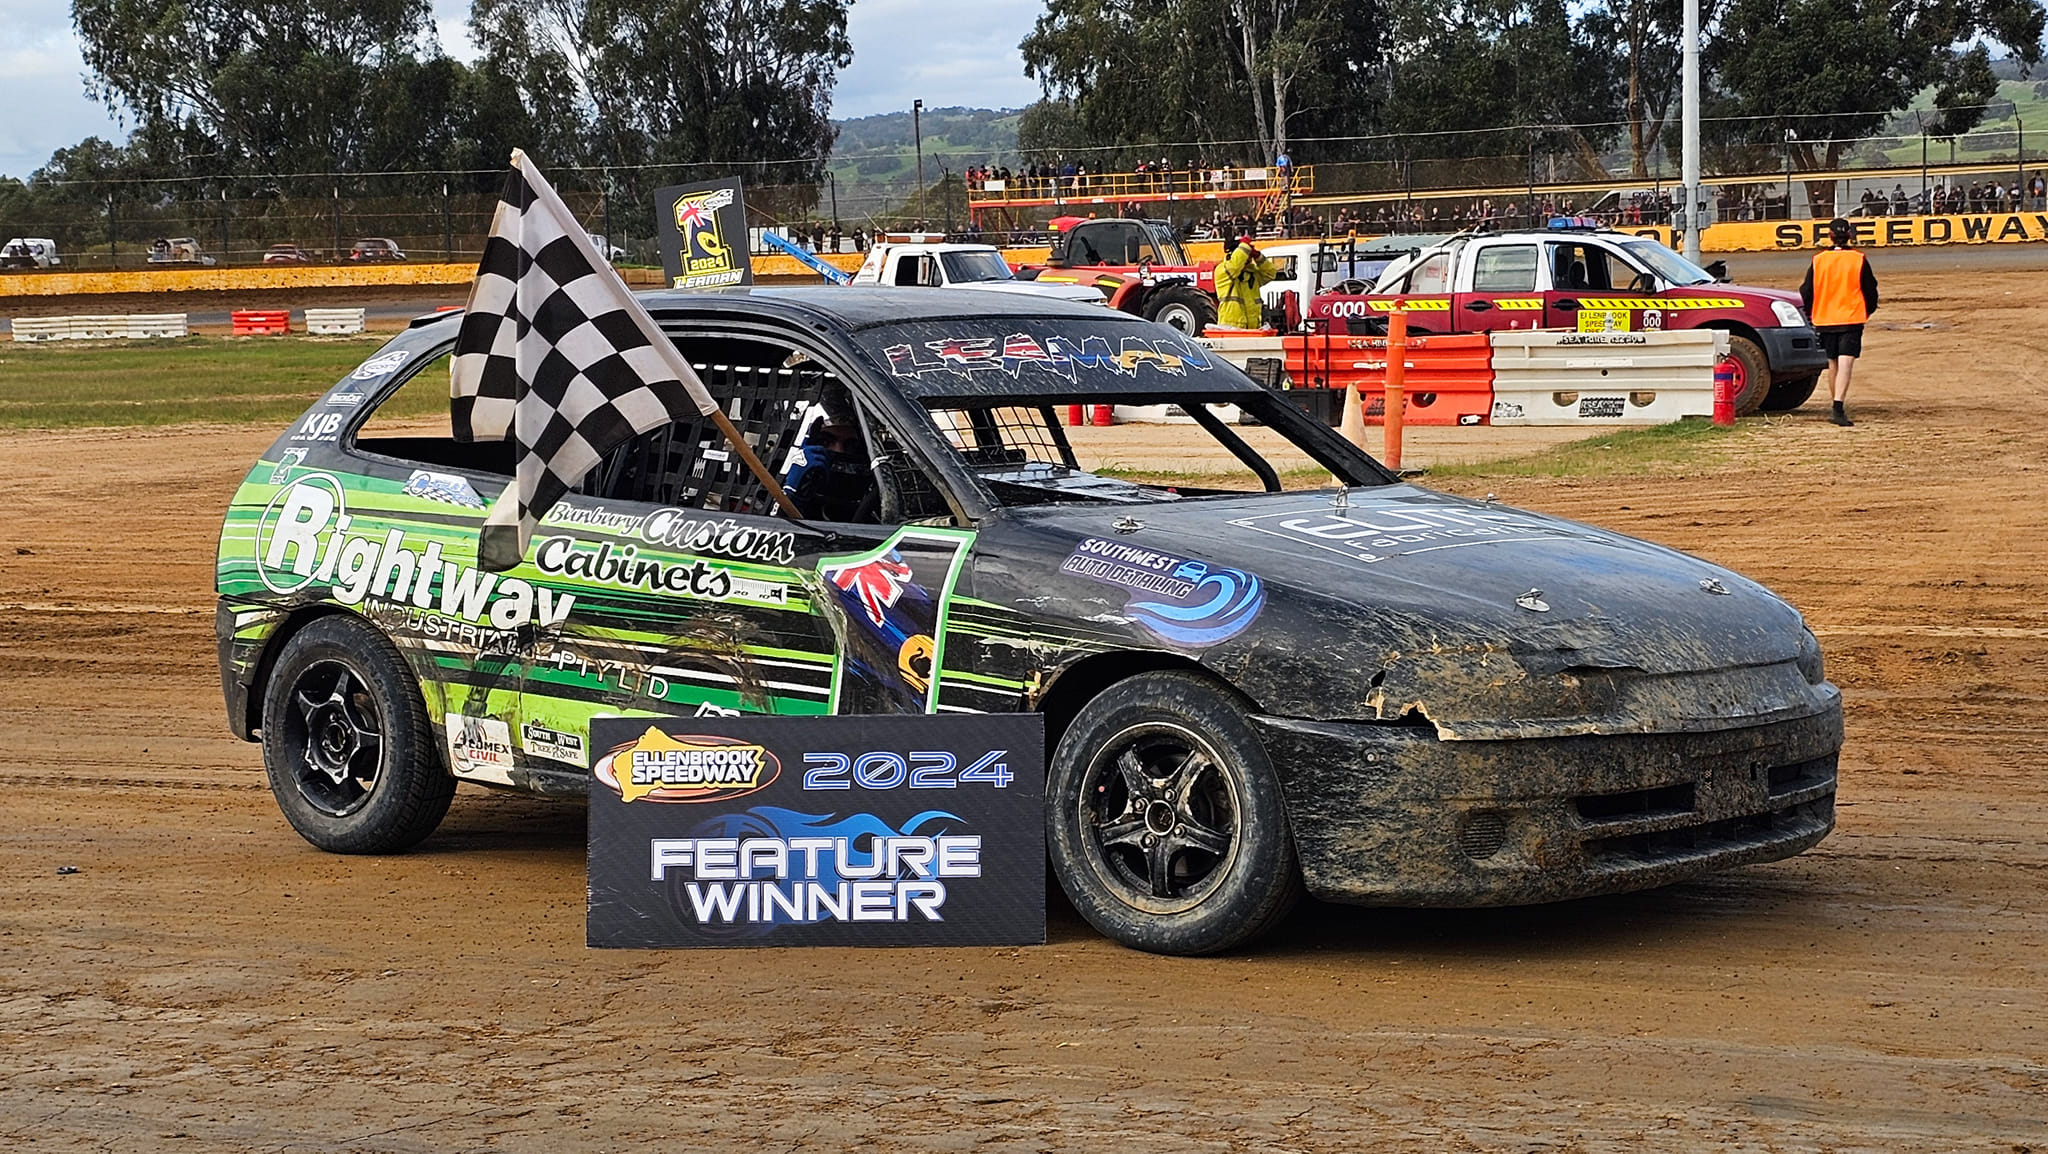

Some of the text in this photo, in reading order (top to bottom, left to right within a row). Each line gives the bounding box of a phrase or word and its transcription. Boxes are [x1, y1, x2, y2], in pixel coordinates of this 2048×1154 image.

[690, 256, 725, 271] 2024
[1332, 301, 1365, 317] 000
[1643, 316, 1661, 327] 000
[884, 332, 1213, 384] LEAMAN
[300, 413, 343, 440] KJB
[548, 502, 795, 564] Bunbury Custom
[264, 483, 577, 638] Rightway
[535, 536, 730, 599] Cabinets
[1079, 538, 1181, 572] SOUTHWEST
[1062, 554, 1195, 599] AUTO DETAILING
[528, 727, 578, 747] SOUTH WEST
[469, 749, 501, 763] CIVIL
[631, 750, 757, 766] ELLENBROOK
[802, 750, 1014, 790] 2024
[631, 764, 757, 784] SPEEDWAY
[650, 835, 983, 881] FEATURE
[684, 880, 949, 924] WINNER
